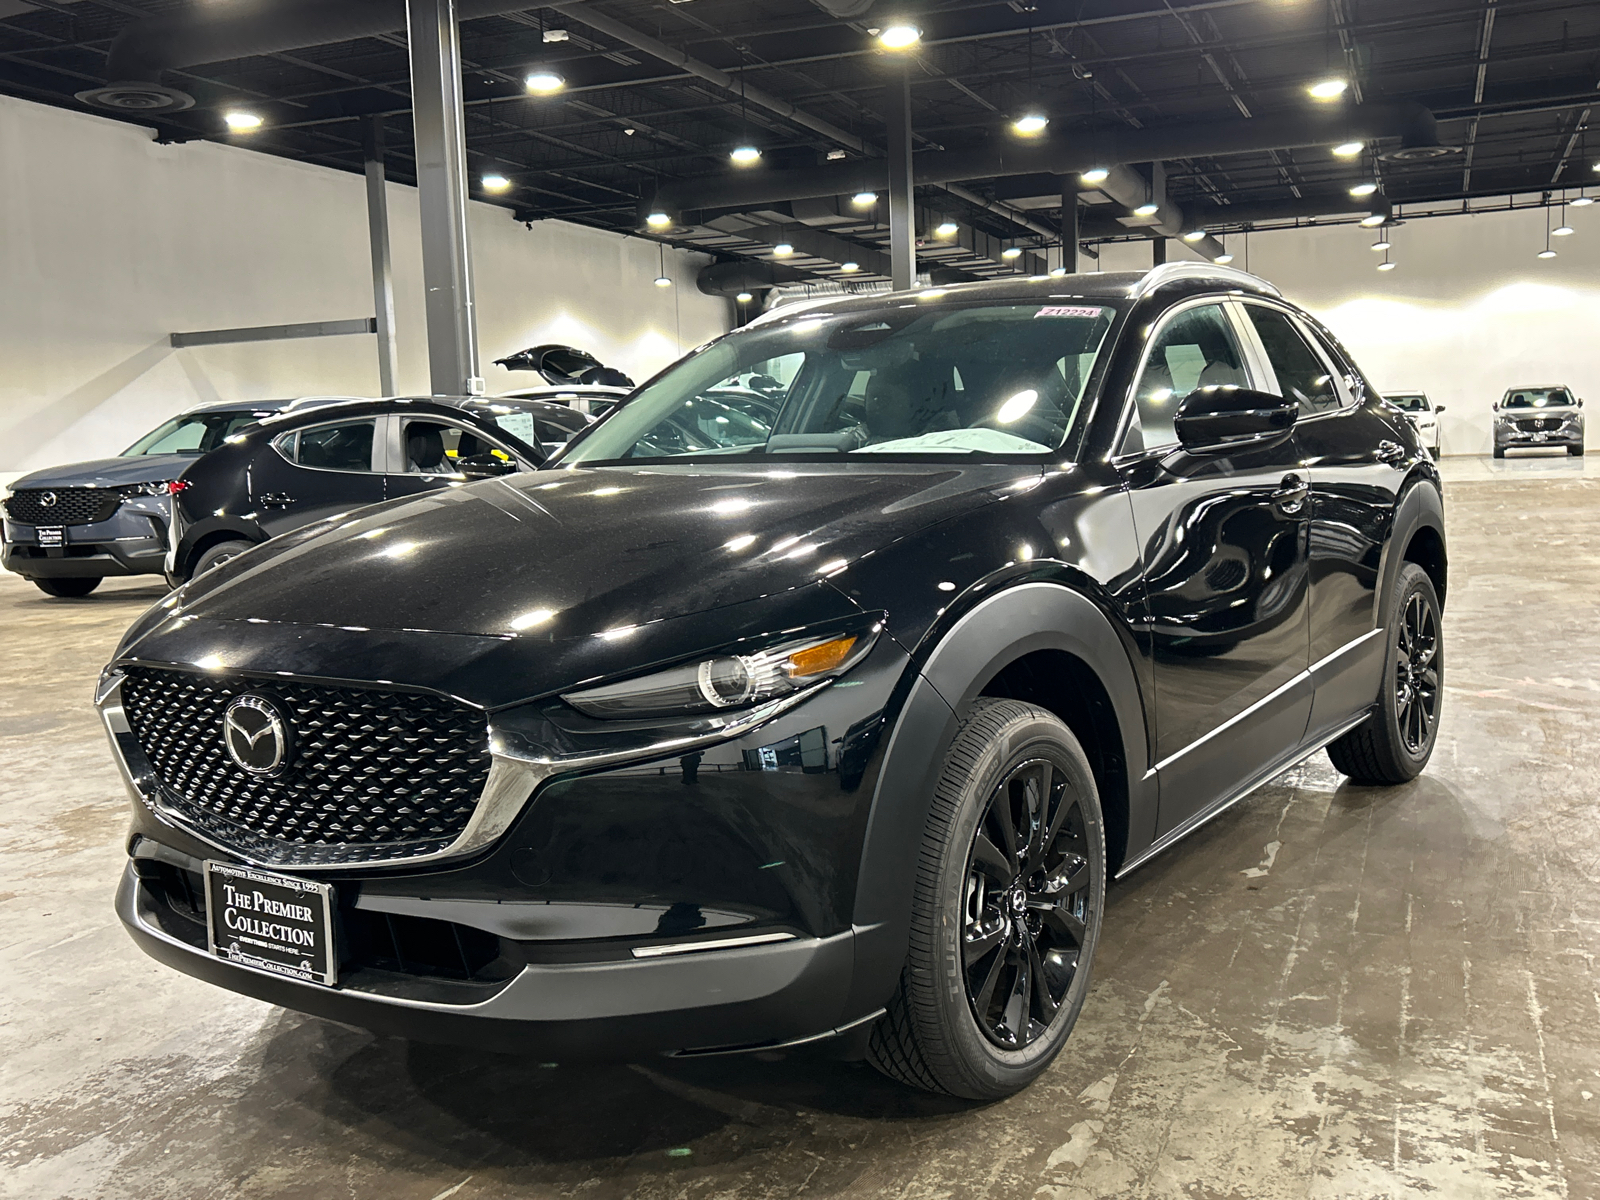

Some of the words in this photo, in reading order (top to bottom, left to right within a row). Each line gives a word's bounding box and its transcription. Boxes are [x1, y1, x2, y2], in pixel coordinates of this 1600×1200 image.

[211, 863, 246, 878] AUTOMOTIVE
[247, 870, 281, 885] EXCELLENCE
[282, 878, 301, 890] SINCE
[302, 882, 319, 892] 1995
[222, 884, 252, 910] THE
[252, 891, 314, 923] PREMIER
[224, 907, 315, 948] COLLECTION
